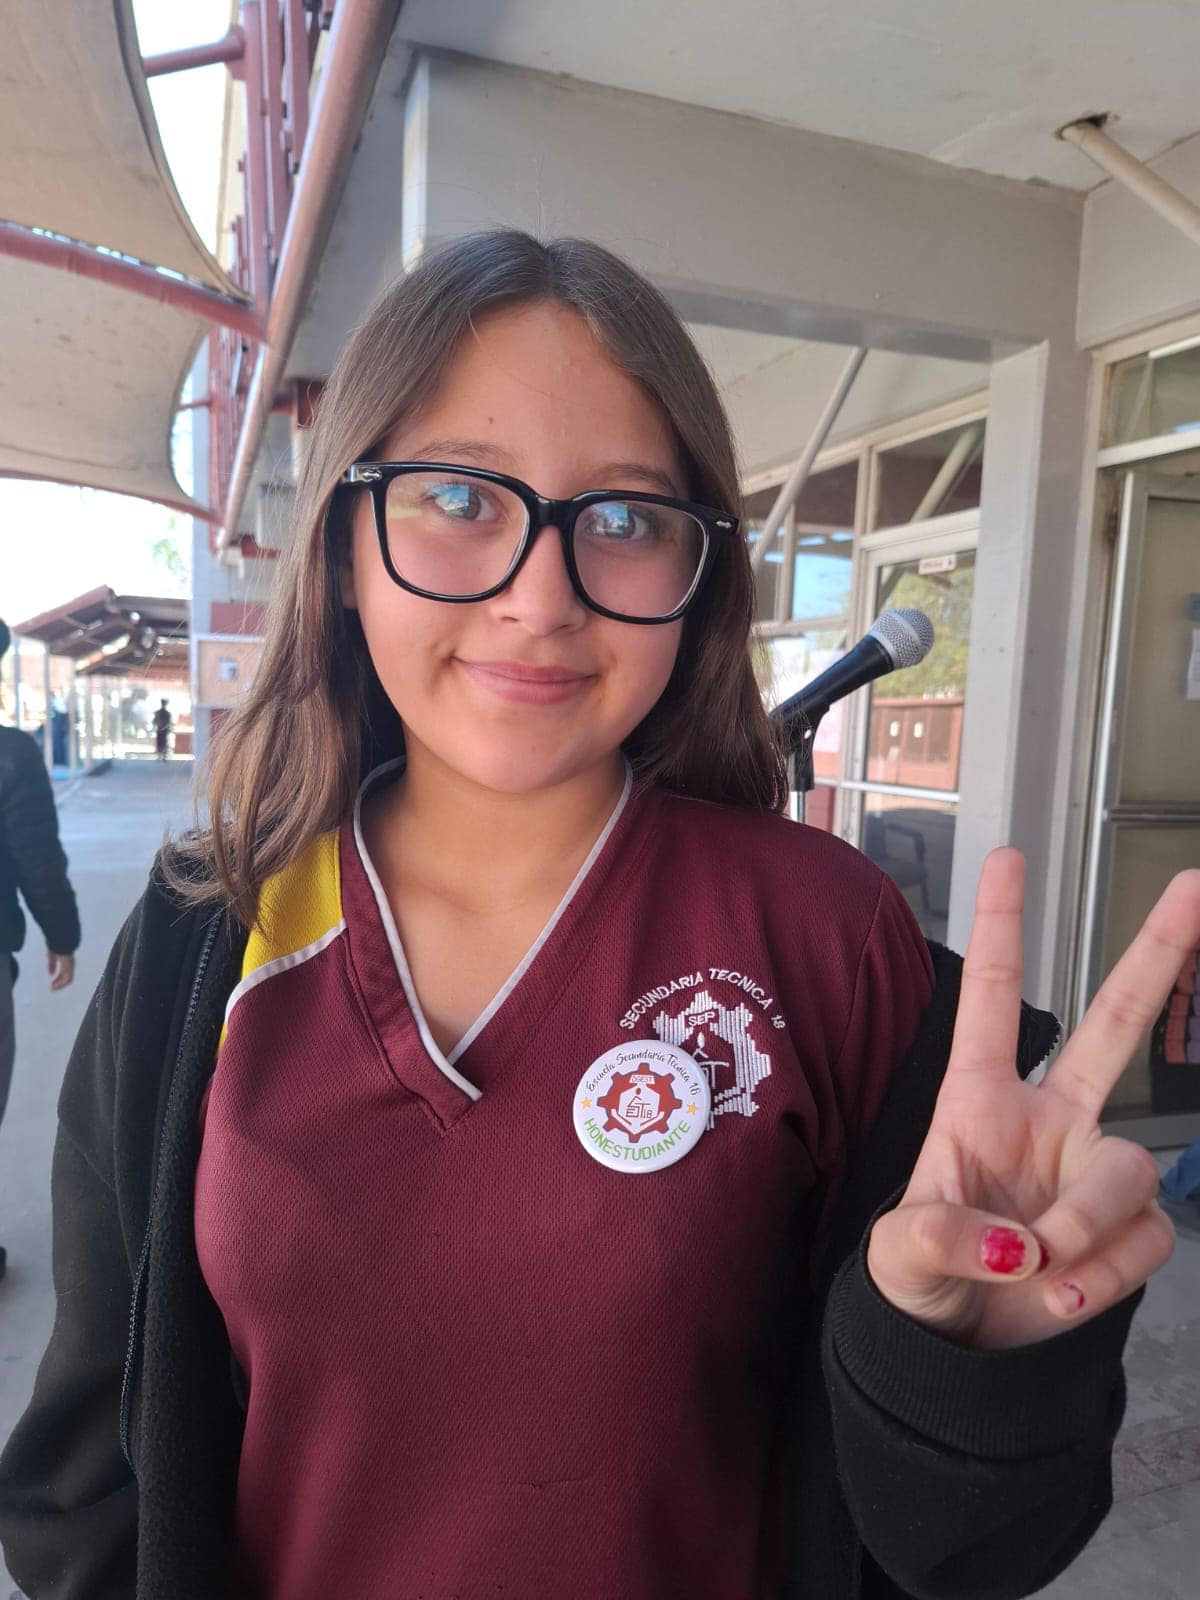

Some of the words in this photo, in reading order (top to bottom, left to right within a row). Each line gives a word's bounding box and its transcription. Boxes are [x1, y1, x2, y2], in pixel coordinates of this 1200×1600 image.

[619, 971, 704, 1030] SECUNDARIA
[708, 968, 773, 1010] TECNICA
[688, 1011, 715, 1027] SEP
[586, 1062, 616, 1092] Escuela
[616, 1049, 665, 1066] Secundaria
[584, 1117, 691, 1161] HONESTUDIANTE
